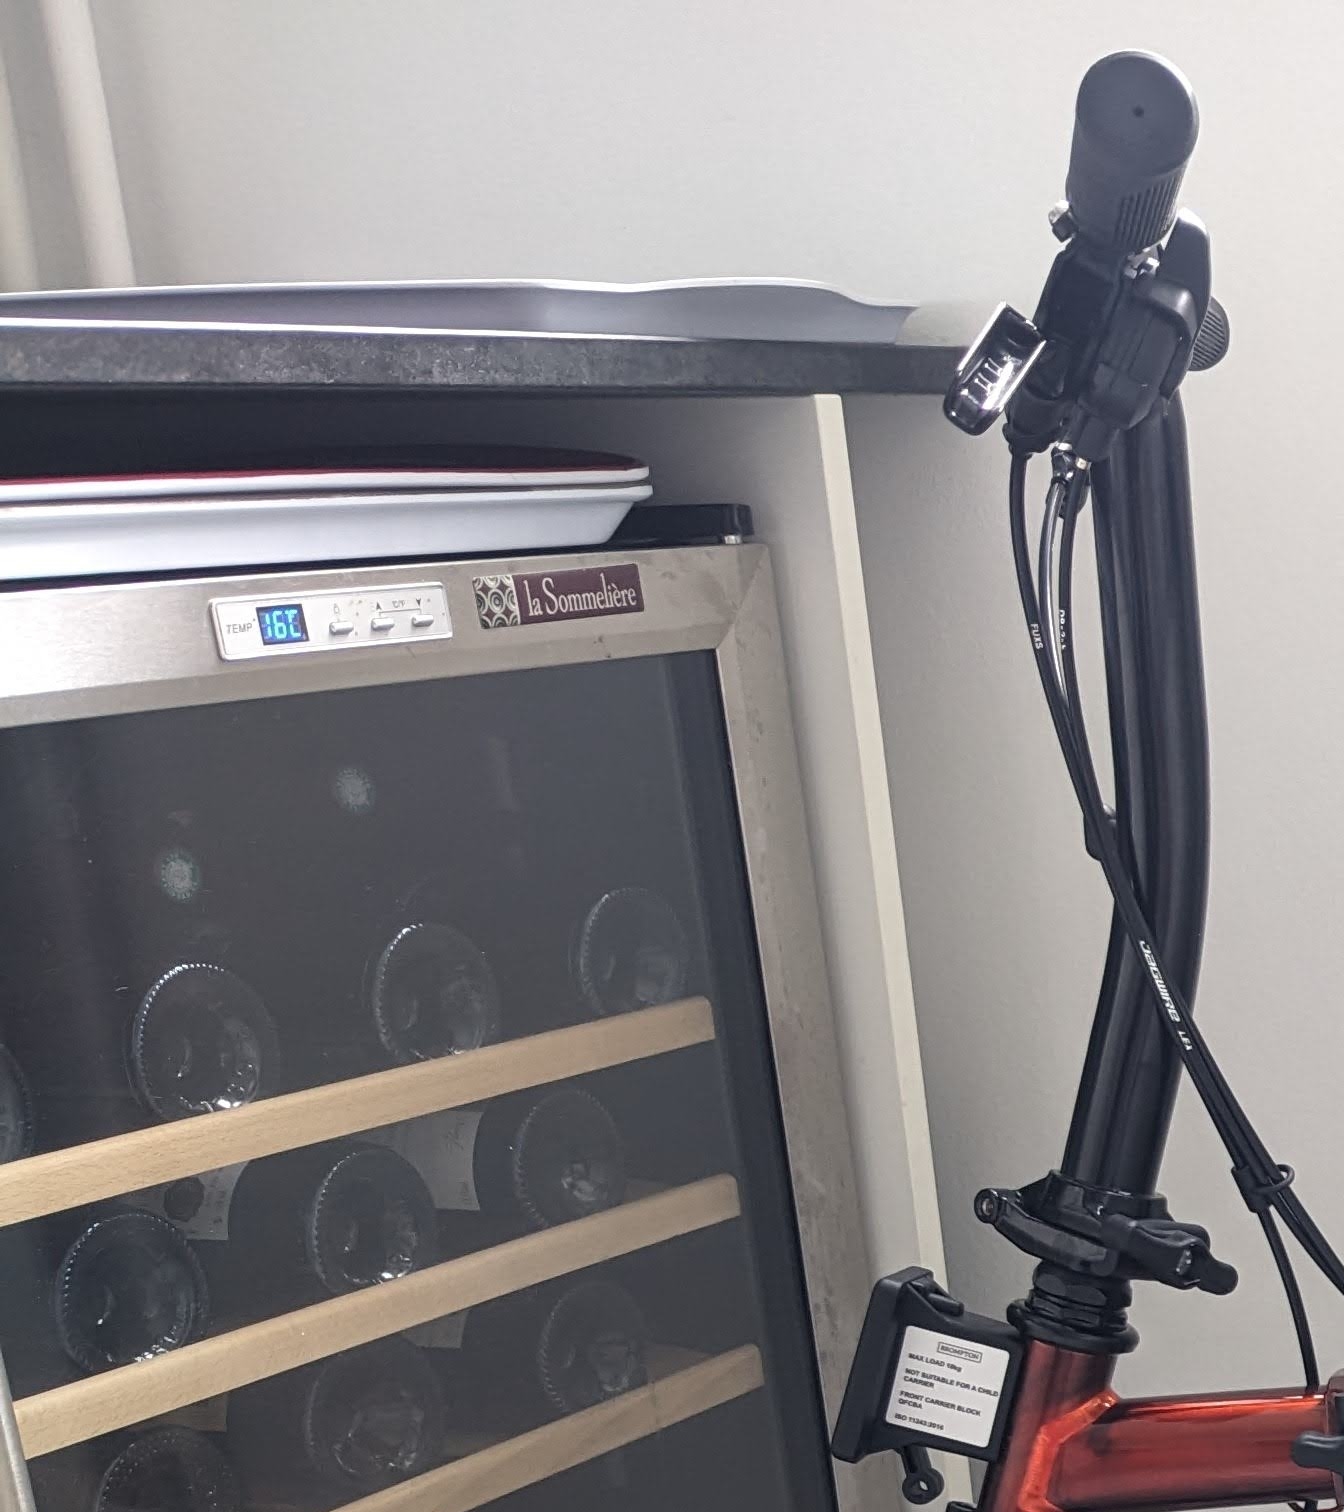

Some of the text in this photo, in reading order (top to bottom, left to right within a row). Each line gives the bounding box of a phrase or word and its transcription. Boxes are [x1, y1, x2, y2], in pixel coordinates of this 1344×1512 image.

[523, 572, 637, 616] la Sommelière
[226, 623, 252, 634] TEMP
[908, 1353, 924, 1361] MAX
[925, 1357, 945, 1367] LOAD
[941, 1345, 979, 1360] BROMPTON
[903, 1375, 935, 1388] CARRIER
[905, 1368, 920, 1376] NOT
[921, 1372, 955, 1386] SUITABLE
[955, 1381, 970, 1390] FOR
[978, 1387, 999, 1397] CHILD
[900, 1390, 981, 1417] FRONT CARRIER BLOCK
